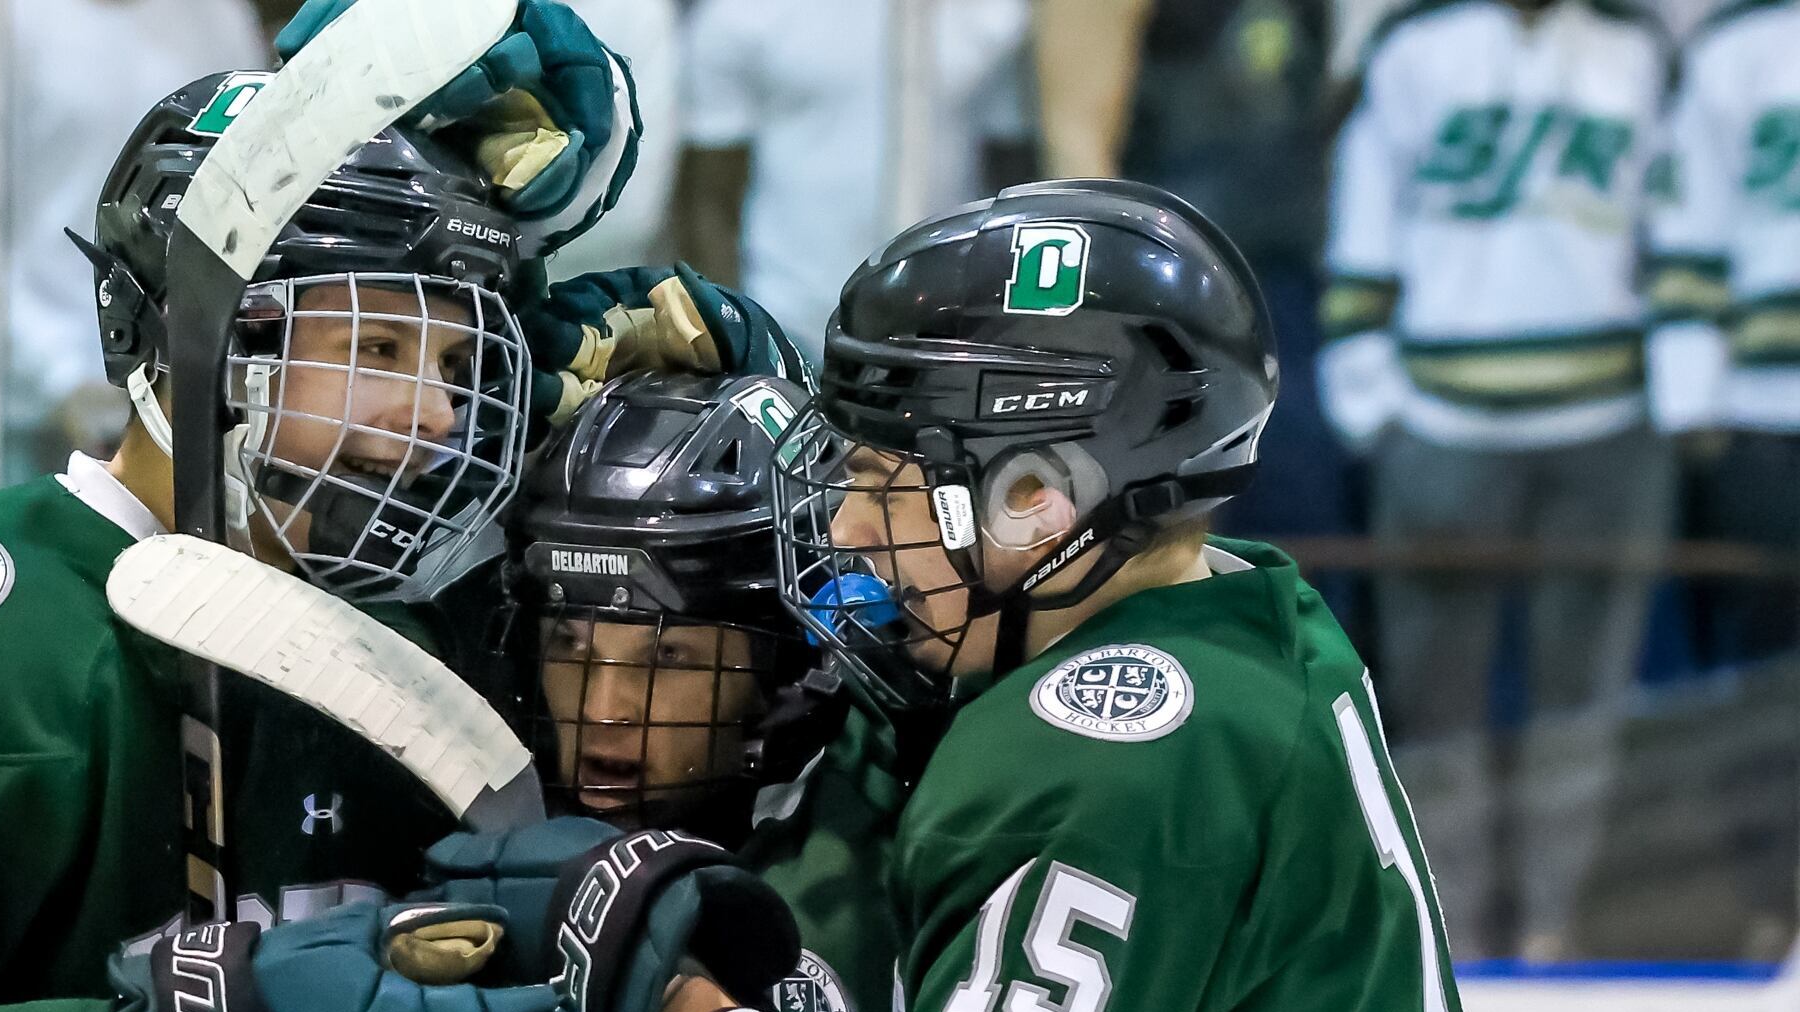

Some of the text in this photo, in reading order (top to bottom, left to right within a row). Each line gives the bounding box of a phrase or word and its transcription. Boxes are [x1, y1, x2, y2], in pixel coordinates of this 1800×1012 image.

[447, 218, 511, 247] BAUER
[1004, 222, 1092, 316] D
[992, 389, 1089, 413] CCM
[938, 491, 957, 541] BAUER
[551, 550, 629, 576] DELBARTON
[1022, 527, 1095, 592] BAUER
[1064, 649, 1178, 674] DELBARTON
[1065, 711, 1149, 733] HOCKEY
